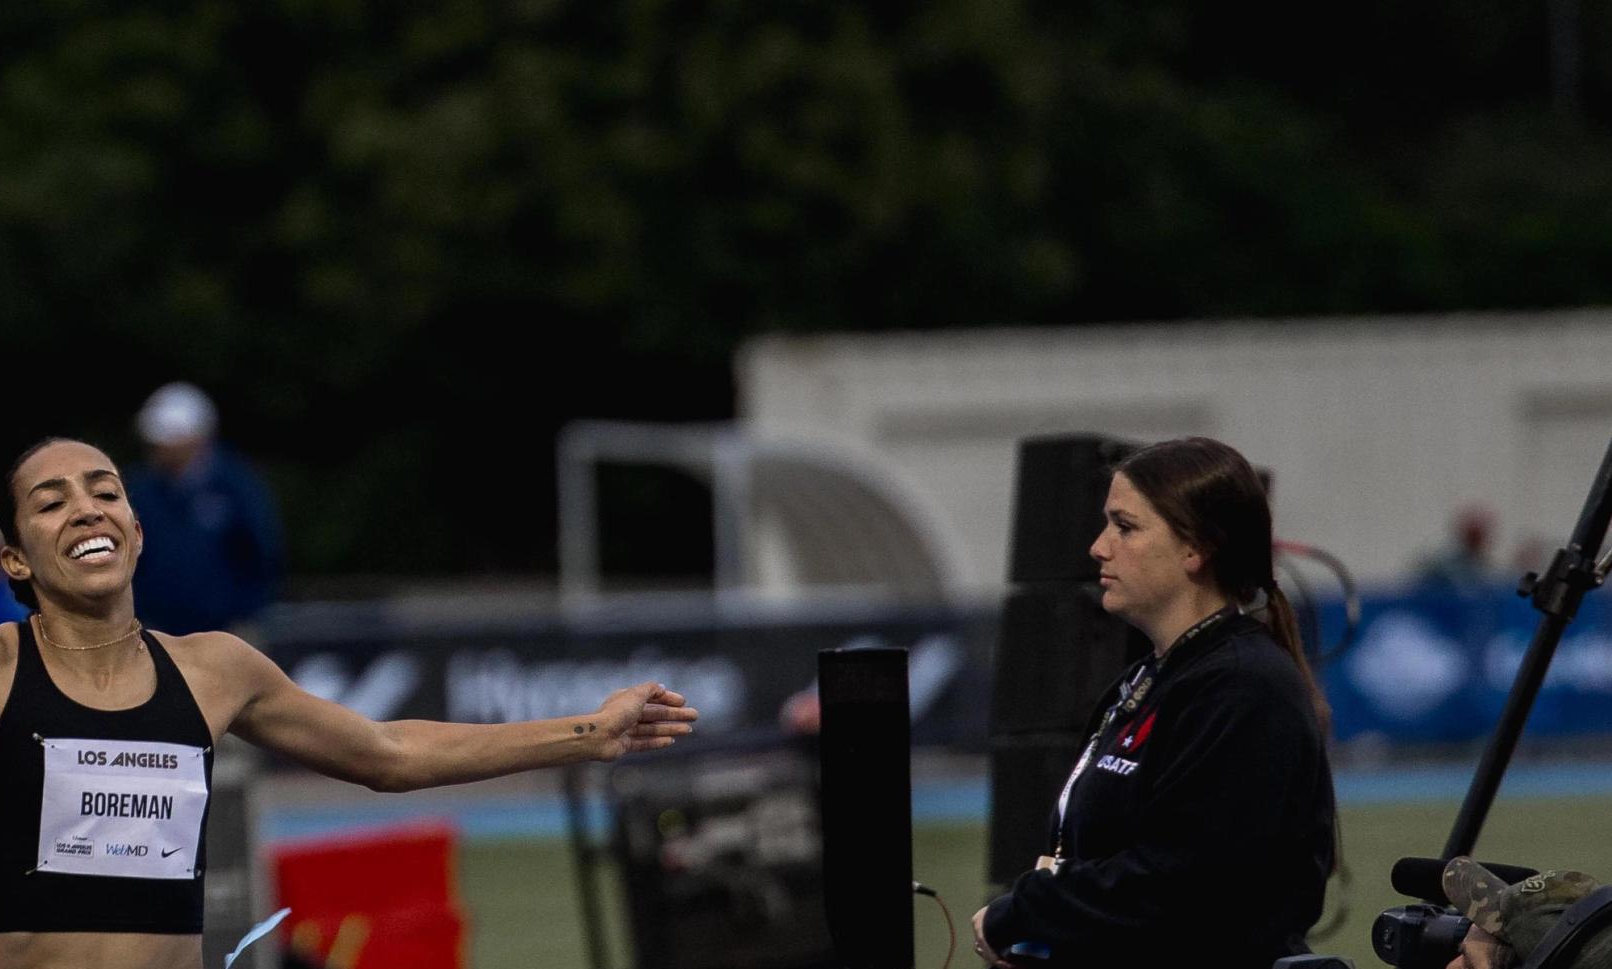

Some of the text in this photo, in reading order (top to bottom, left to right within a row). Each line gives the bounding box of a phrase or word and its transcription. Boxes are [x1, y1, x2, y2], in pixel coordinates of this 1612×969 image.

[78, 750, 178, 770] LOS ANGELES
[1096, 754, 1139, 776] USATF
[81, 791, 173, 820] BOREMAN
[106, 843, 148, 857] WebMD
